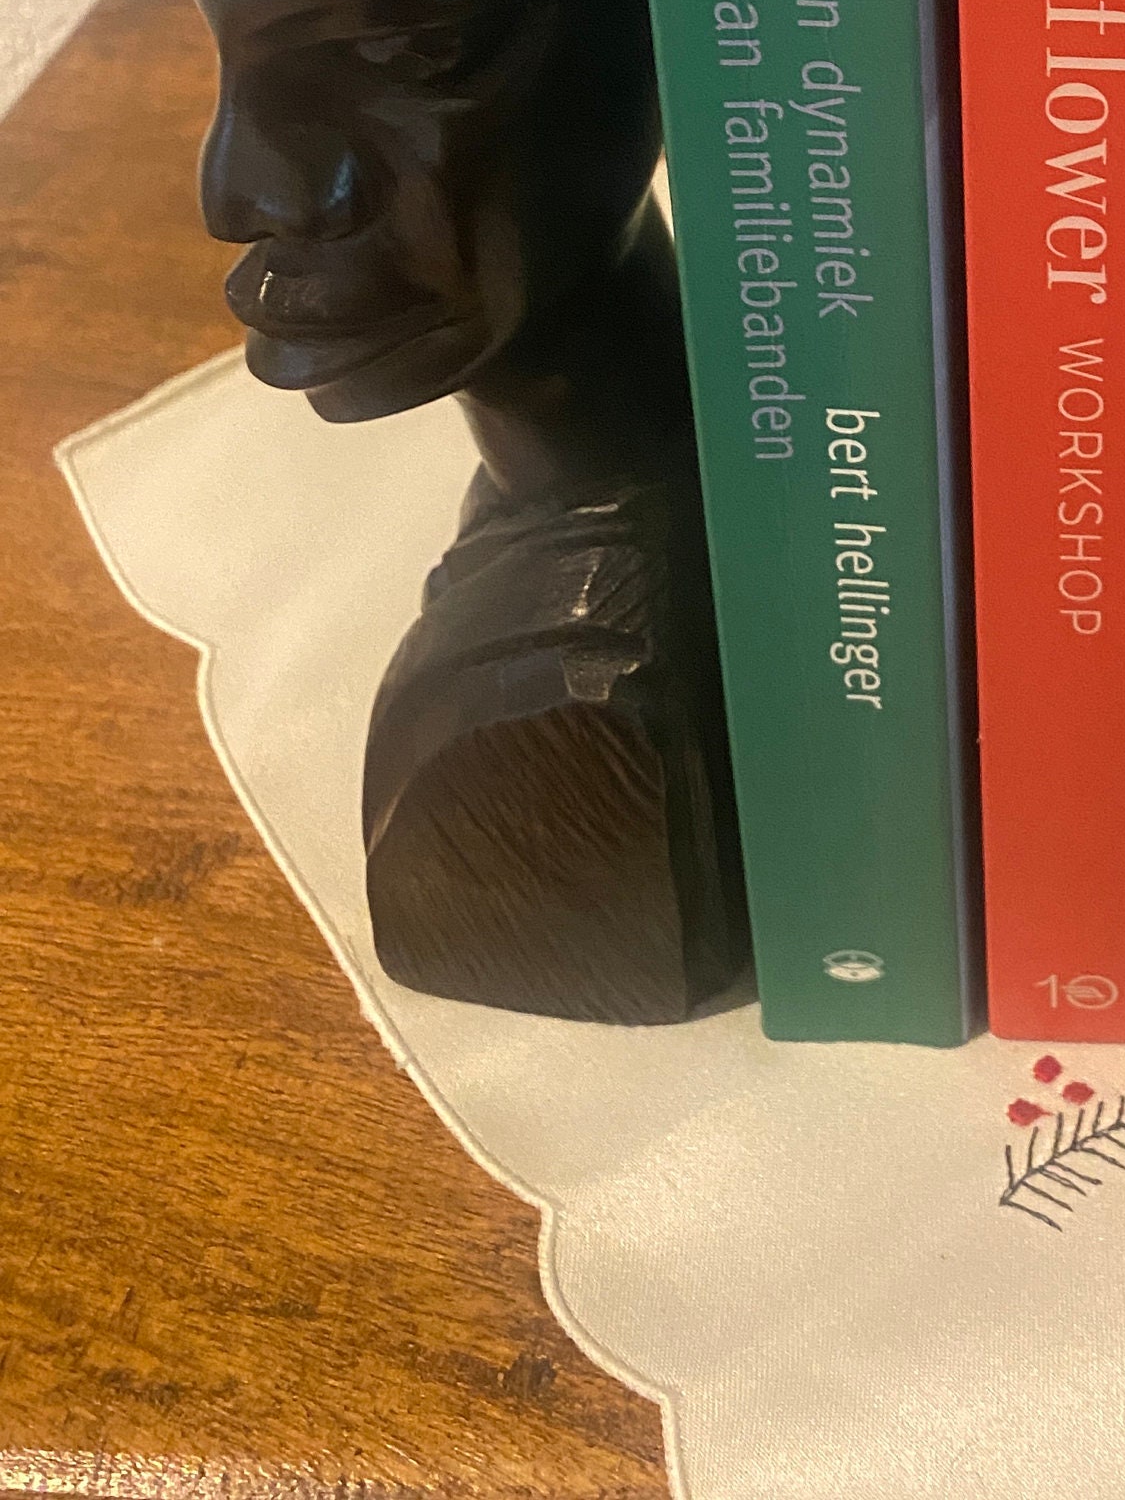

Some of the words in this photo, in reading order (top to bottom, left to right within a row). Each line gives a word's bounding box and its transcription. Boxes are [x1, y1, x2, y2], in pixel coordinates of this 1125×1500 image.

[723, 99, 807, 461] familiebanden
[787, 59, 875, 318] dynamiek
[825, 407, 881, 499] bert
[1057, 338, 1104, 635] WORKSHOP
[829, 521, 891, 711] hellinger
